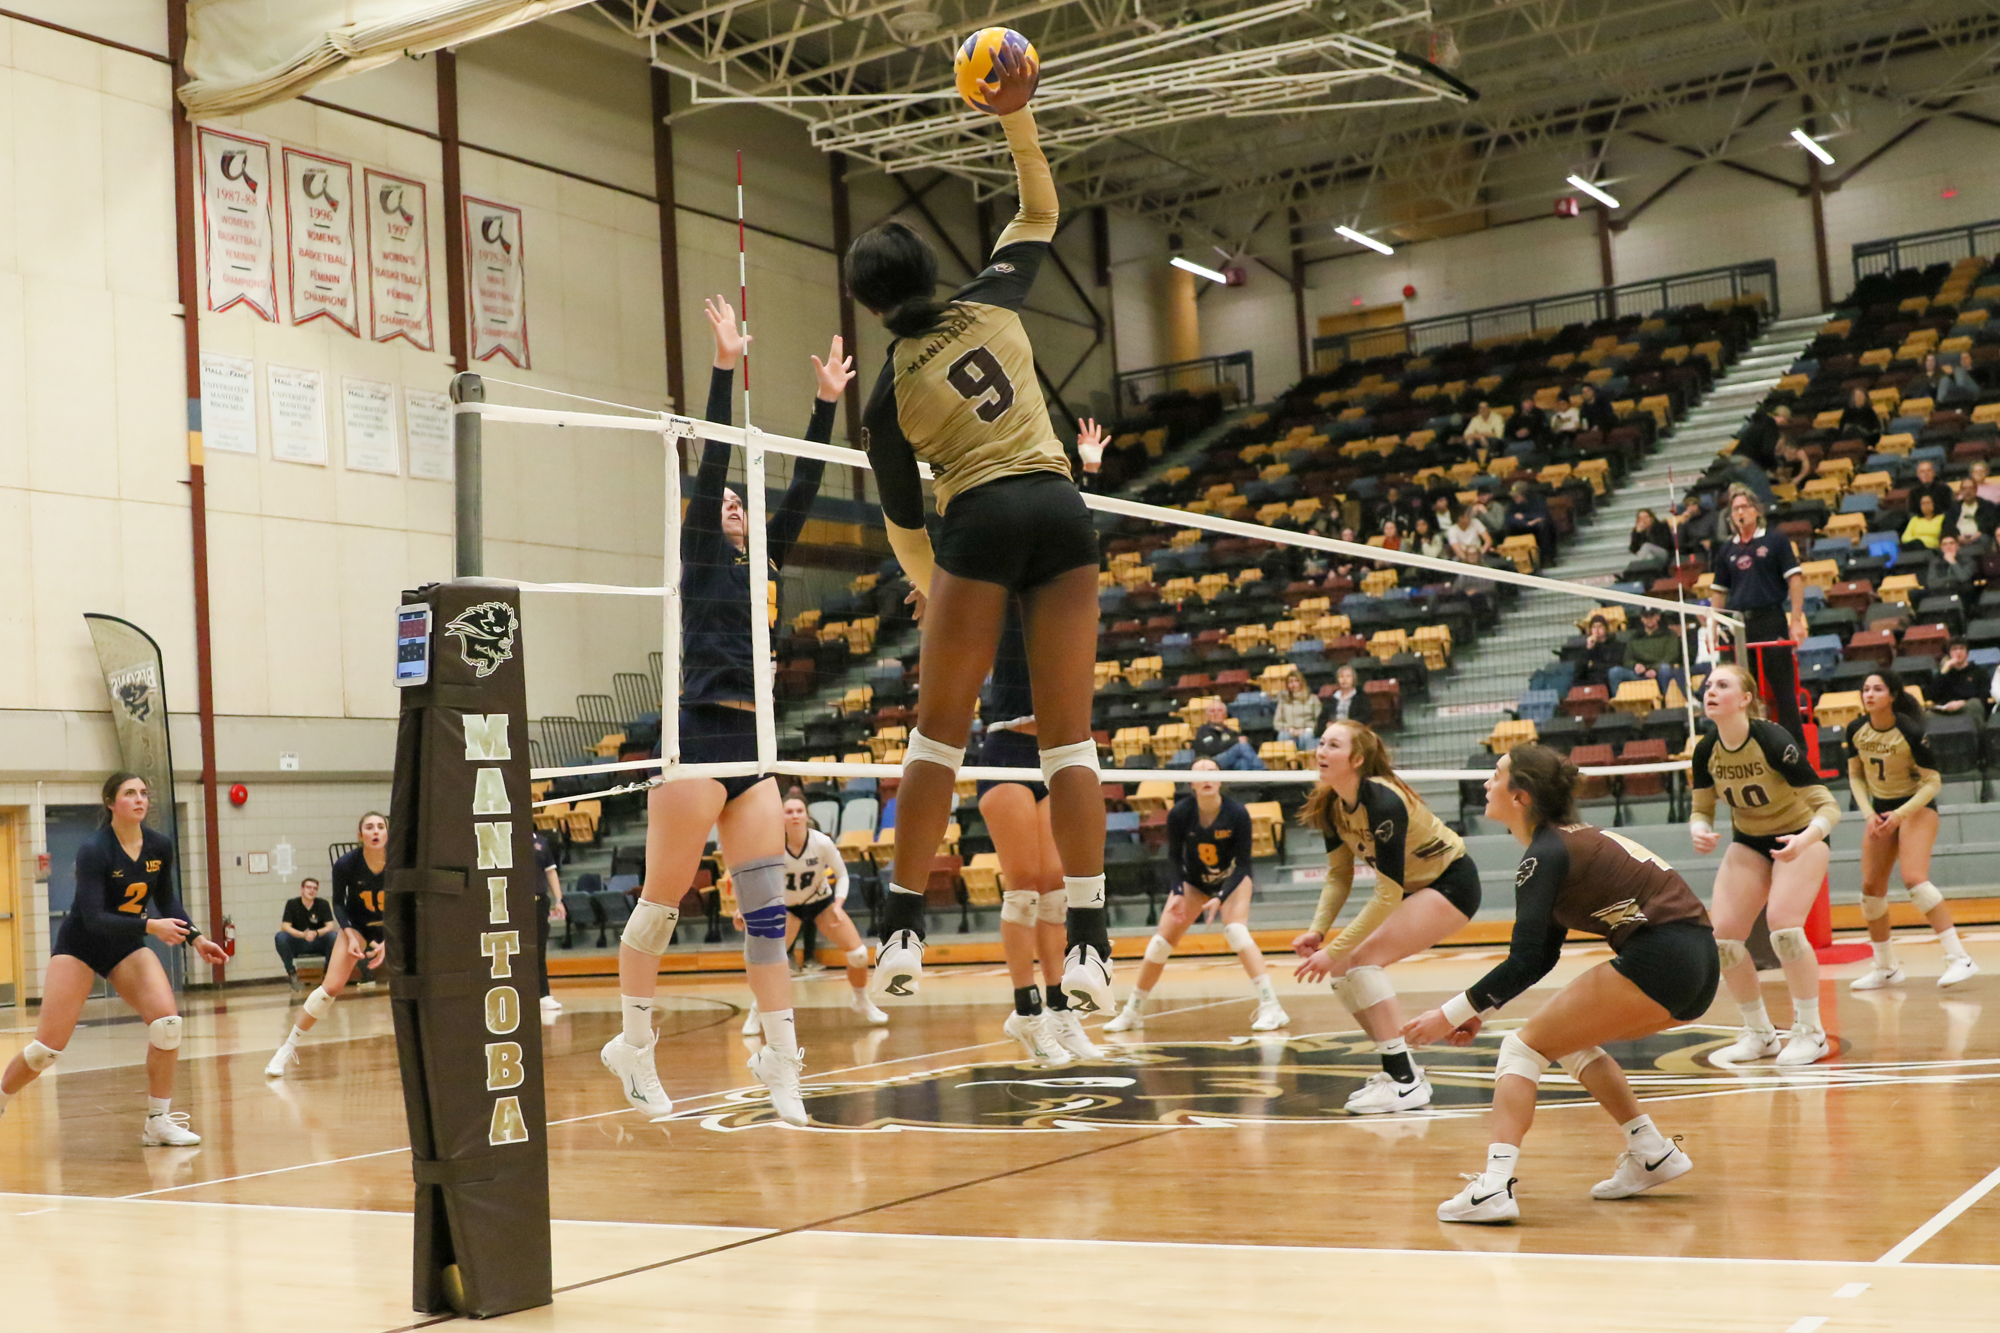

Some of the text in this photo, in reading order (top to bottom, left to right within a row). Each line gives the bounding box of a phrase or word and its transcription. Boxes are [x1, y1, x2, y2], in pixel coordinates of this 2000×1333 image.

[217, 188, 258, 206] 1987-88
[309, 206, 333, 222] 1996
[306, 229, 341, 245] WOMEN'S
[387, 222, 410, 236] 1997
[217, 230, 262, 247] BASKETBALL
[298, 247, 348, 266] BASKETBALL
[382, 251, 416, 266] WOMEN'S
[375, 266, 422, 286] BASKETBALL
[304, 290, 347, 307] CHAMPIONS
[204, 366, 222, 375] HALL
[229, 370, 247, 379] FAME
[946, 345, 1015, 424] 9
[1716, 762, 1764, 780] BISONS
[1870, 757, 1886, 781] 7
[1723, 784, 1770, 808] 10
[1198, 843, 1219, 866] 8
[118, 882, 148, 914] 2
[462, 714, 529, 1146] MANITOBA
